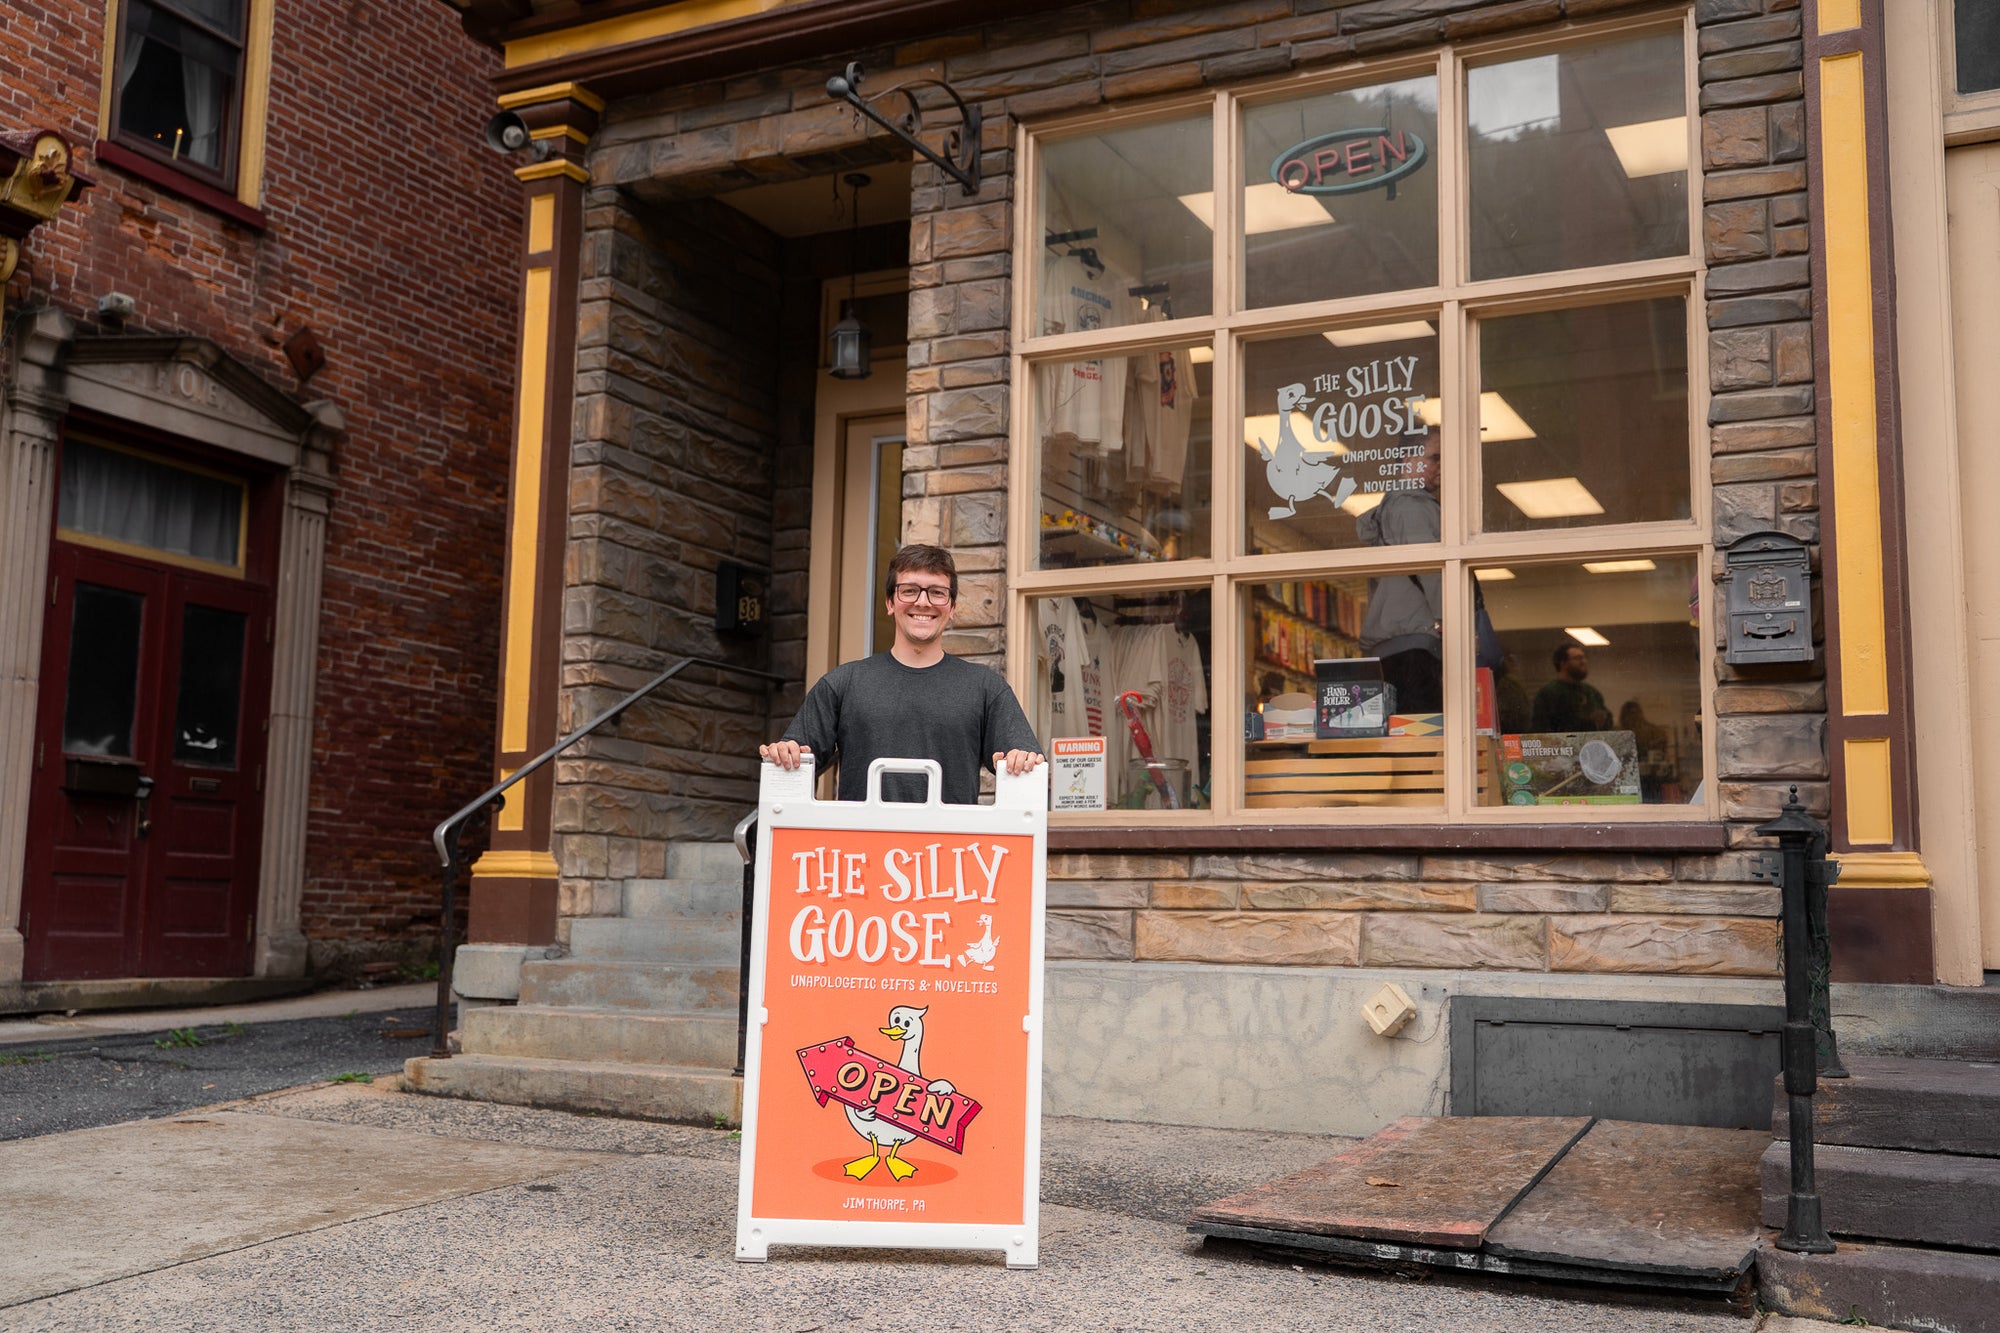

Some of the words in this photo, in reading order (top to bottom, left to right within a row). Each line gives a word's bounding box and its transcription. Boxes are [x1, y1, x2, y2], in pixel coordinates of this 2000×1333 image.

[1280, 131, 1407, 190] OPEN
[1313, 374, 1340, 393] THE
[1345, 356, 1419, 398] SILLY
[1313, 394, 1428, 443] GOOSE
[1342, 445, 1425, 463] UNAPOLOGETIC
[1379, 462, 1413, 476] GIFTS
[1416, 461, 1427, 473] &
[1363, 477, 1426, 493] NOVELTIES
[741, 599, 756, 618] 38
[1323, 696, 1350, 706] BOILER
[1326, 687, 1347, 697] HAND
[1057, 742, 1101, 753] WARNING
[1521, 740, 1541, 748] WOOD
[1522, 747, 1559, 757] BUTTERFLY
[1560, 747, 1574, 756] NET
[791, 846, 867, 898] THE
[879, 842, 1009, 903] SILLY
[789, 905, 951, 969] GOOSE
[791, 974, 877, 990] UNAPOLOGETIC
[881, 978, 915, 992] GIFTS
[919, 979, 931, 992] &
[935, 980, 998, 994] NOVELTIES
[837, 1061, 954, 1129] OPEN
[842, 1197, 865, 1210] JIM
[866, 1198, 909, 1212] THORPE,
[912, 1199, 925, 1212] PA
